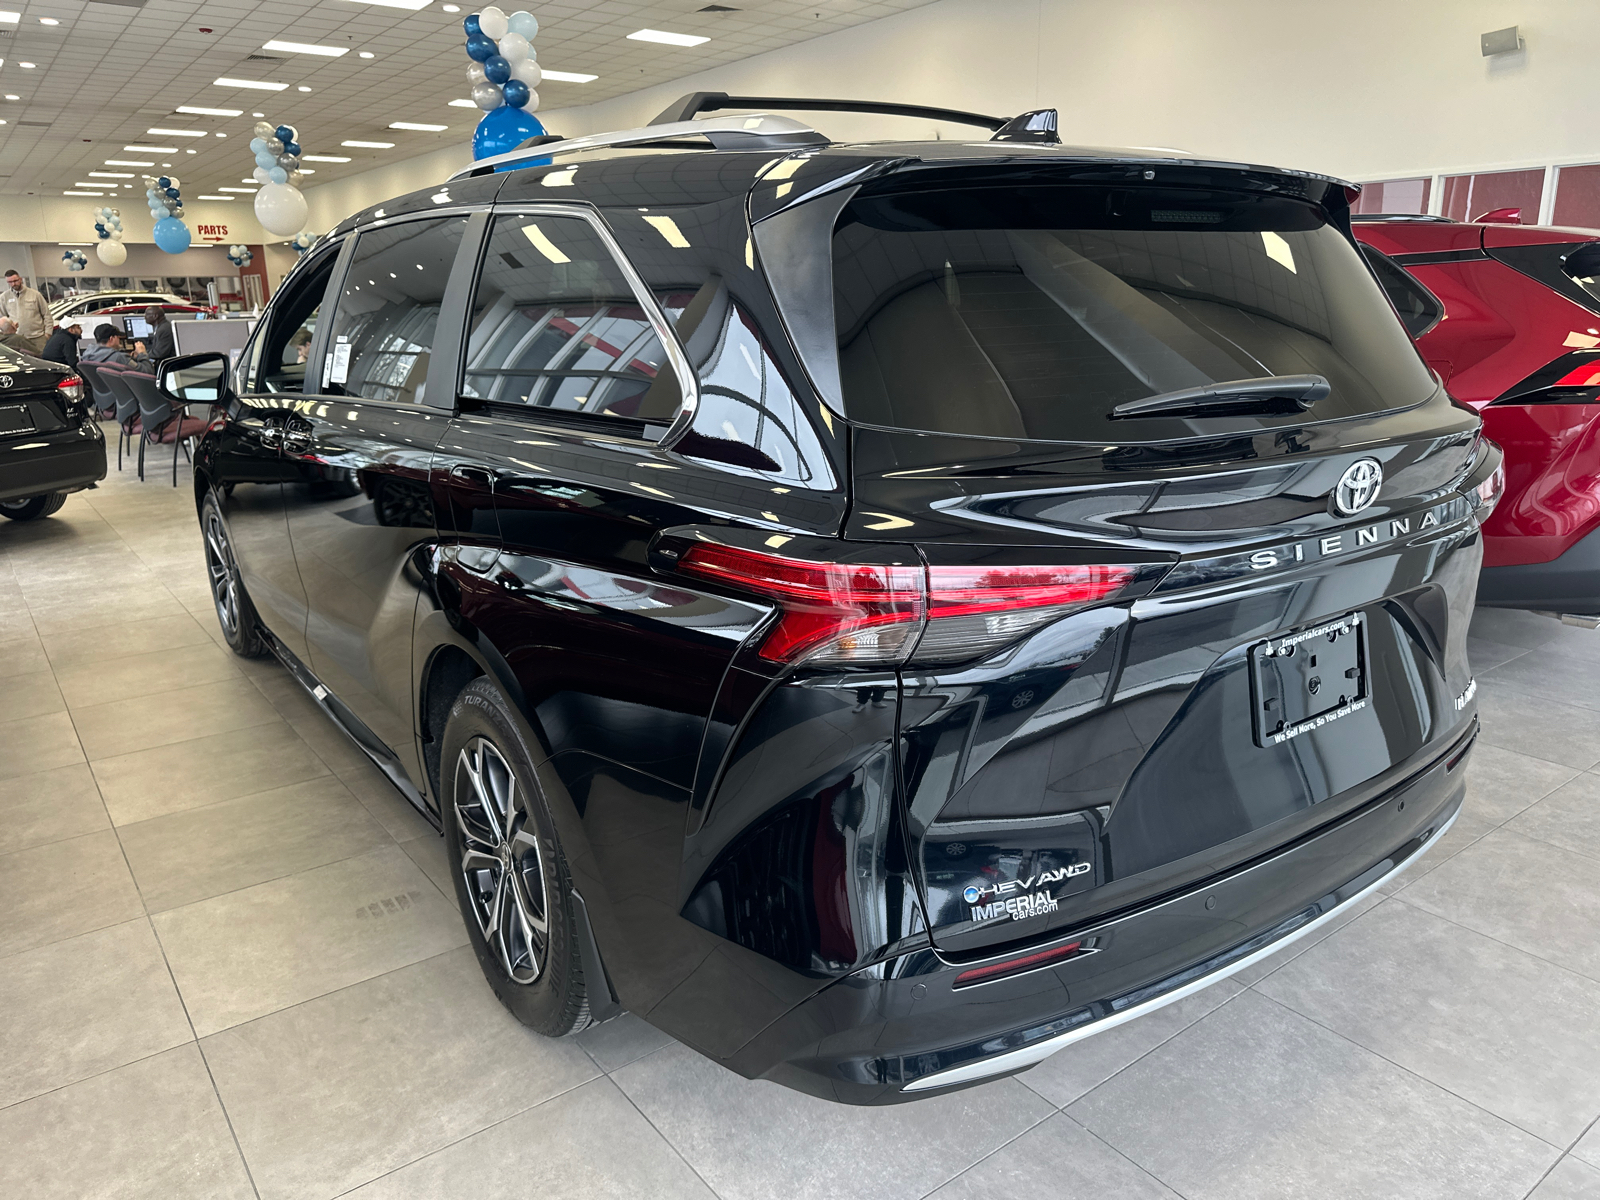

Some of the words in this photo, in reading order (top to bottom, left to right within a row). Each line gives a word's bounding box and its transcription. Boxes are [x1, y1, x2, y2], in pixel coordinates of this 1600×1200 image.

[197, 224, 229, 236] PARTS
[1249, 511, 1441, 570] SIENNA
[1281, 621, 1345, 647] Imperialcars.com
[1274, 734, 1286, 744] We
[1286, 727, 1298, 739] Sell
[1317, 718, 1325, 727] So
[1325, 713, 1337, 723] You
[1337, 707, 1351, 718] Save
[1352, 701, 1366, 712] More
[1036, 862, 1092, 887] AWD
[971, 890, 1058, 922] IMPERIAL
[1012, 902, 1059, 921] cars.com
